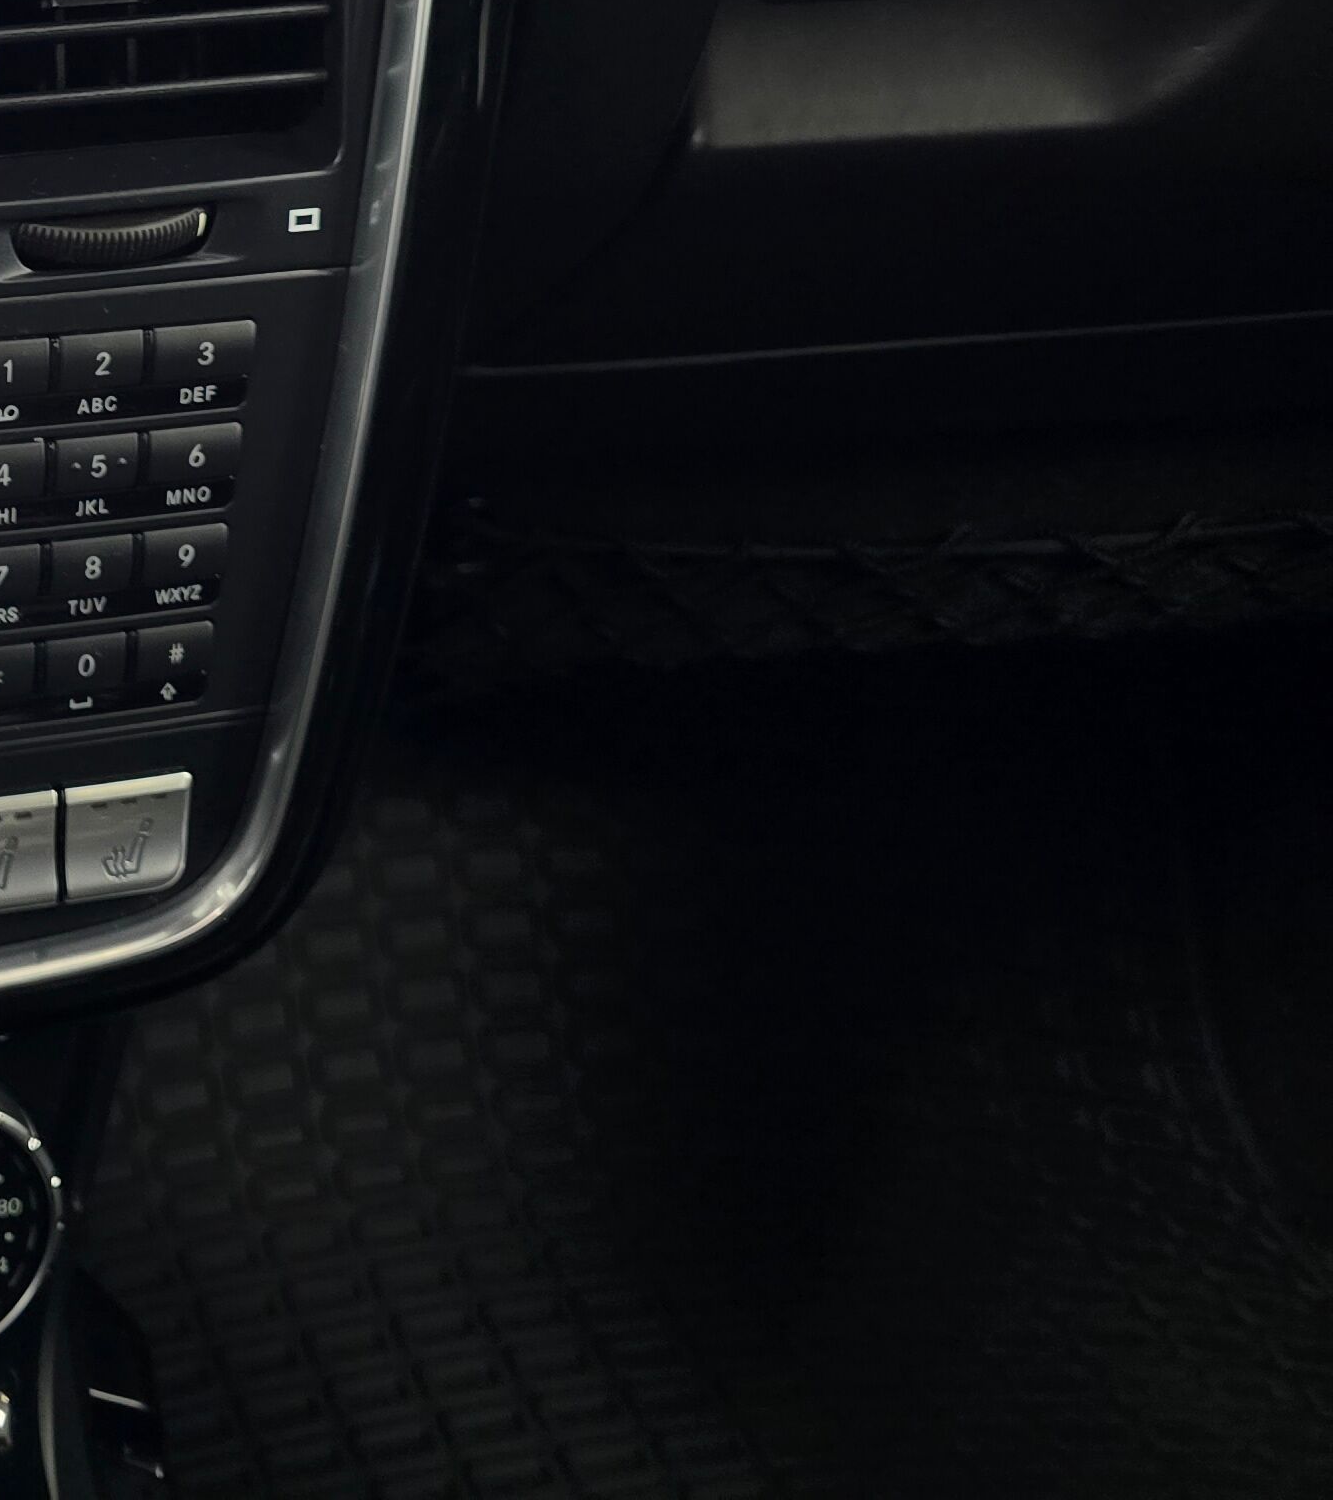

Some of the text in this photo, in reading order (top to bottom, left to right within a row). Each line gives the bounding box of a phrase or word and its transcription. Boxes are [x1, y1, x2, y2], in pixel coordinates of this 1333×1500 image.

[95, 352, 111, 376] 2
[197, 341, 215, 366] 3
[2, 360, 14, 383] 1
[76, 395, 118, 416] ABC
[178, 384, 217, 405] DEF
[90, 454, 107, 478] 5
[189, 443, 206, 467] 6
[166, 486, 211, 505] MNO
[75, 498, 109, 517] JKL
[84, 555, 102, 579] 8
[178, 543, 196, 568] 9
[68, 596, 108, 615] TUV
[155, 583, 203, 605] WXYZ
[78, 653, 96, 677] 0
